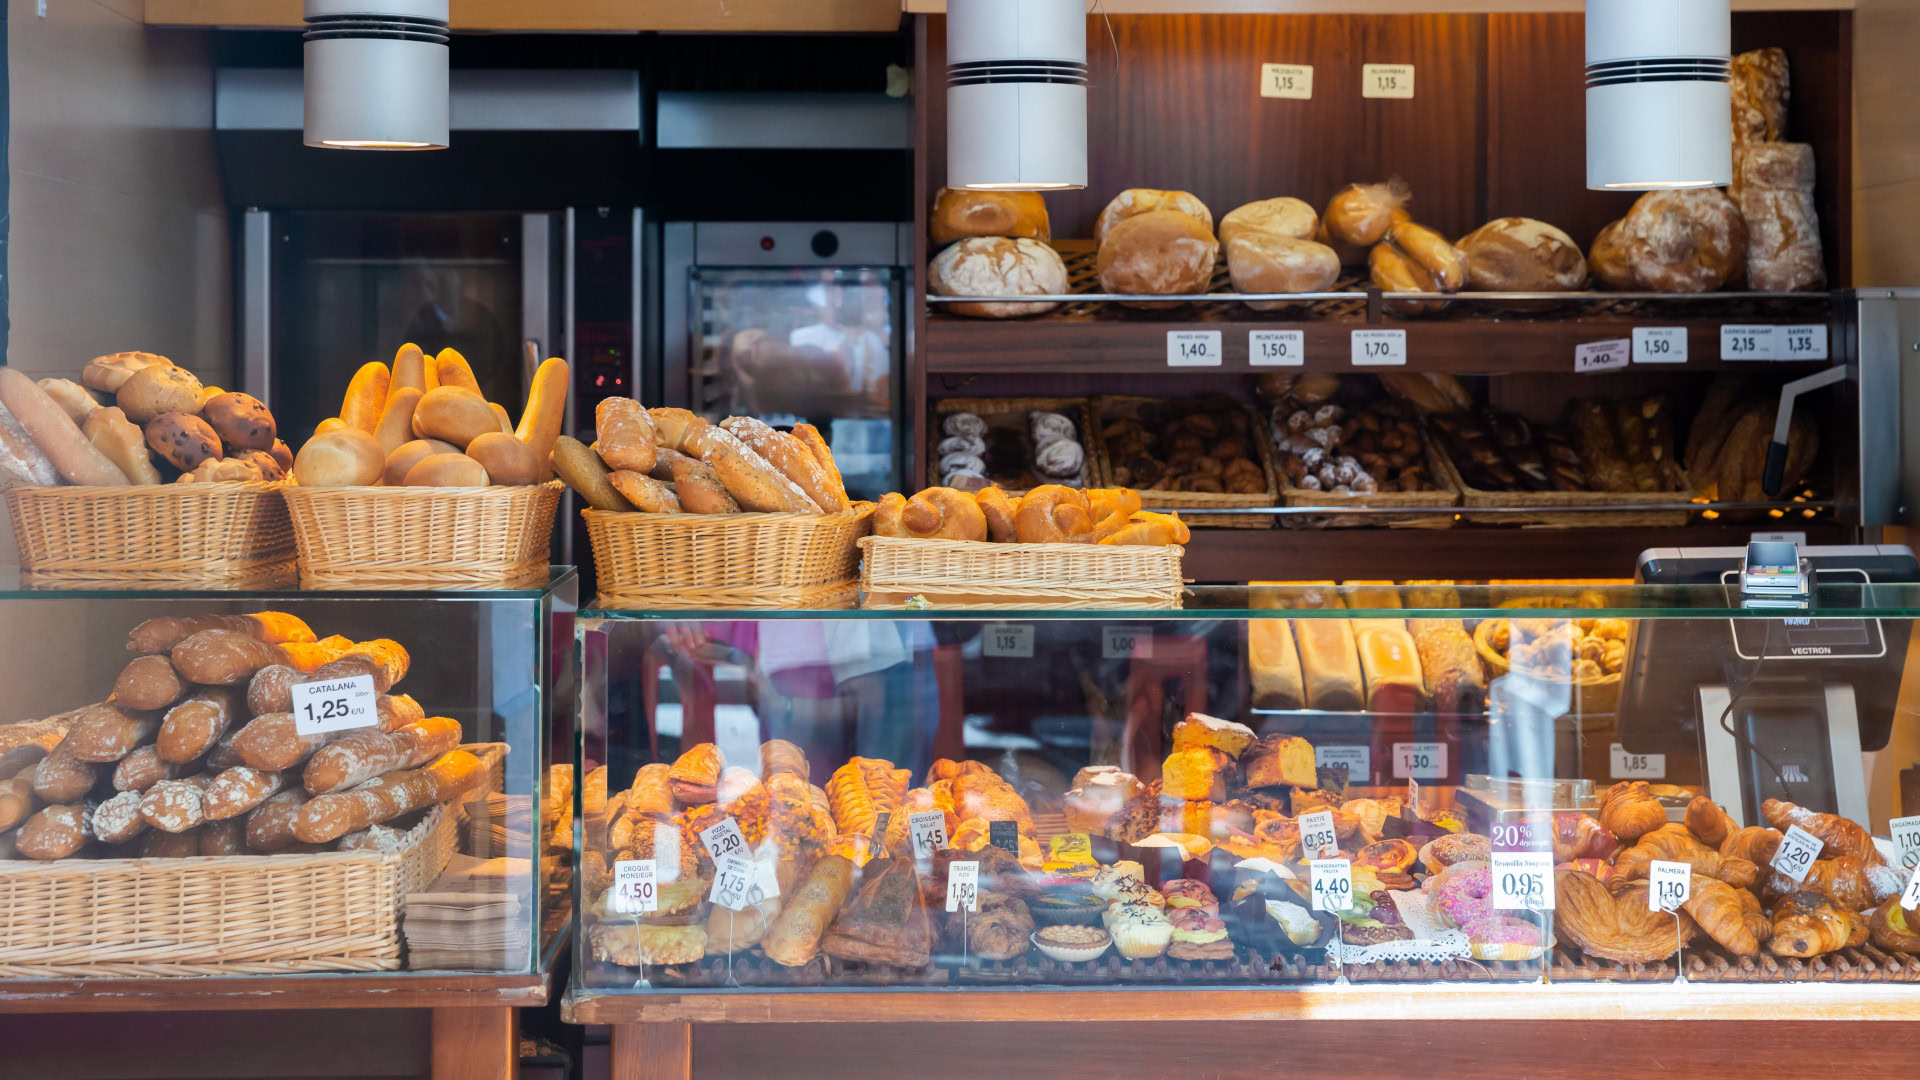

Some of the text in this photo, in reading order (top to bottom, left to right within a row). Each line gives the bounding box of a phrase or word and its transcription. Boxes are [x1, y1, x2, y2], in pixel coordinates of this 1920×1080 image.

[1275, 76, 1294, 91] 1,15
[1378, 76, 1396, 91] 1,15
[1181, 342, 1207, 359] 1,40
[1262, 343, 1287, 358] 1,50
[1365, 342, 1389, 358] 1,70
[1645, 339, 1670, 355] 1,50
[1732, 337, 1755, 353] 2,15
[1788, 337, 1812, 353] 1,35
[1582, 353, 1610, 366] 1,40
[996, 636, 1016, 651] 1,15
[1791, 646, 1832, 655] VECTRON
[308, 681, 357, 695] CATALANA
[303, 698, 365, 724] 1,25 €/U
[1404, 754, 1430, 771] 1,30
[1623, 755, 1648, 773] 1,85
[911, 814, 943, 824] CROISSANT
[711, 824, 726, 835] PIZZA
[1898, 831, 1920, 851] 1,10
[1782, 841, 1810, 865] 1,20
[620, 872, 654, 880] MONSIEUR
[623, 865, 651, 873] CROQUE
[1657, 866, 1686, 875] PALMERA
[720, 871, 746, 892] 1,75
[1501, 872, 1545, 900] 0,95
[1657, 880, 1685, 900] 1,10
